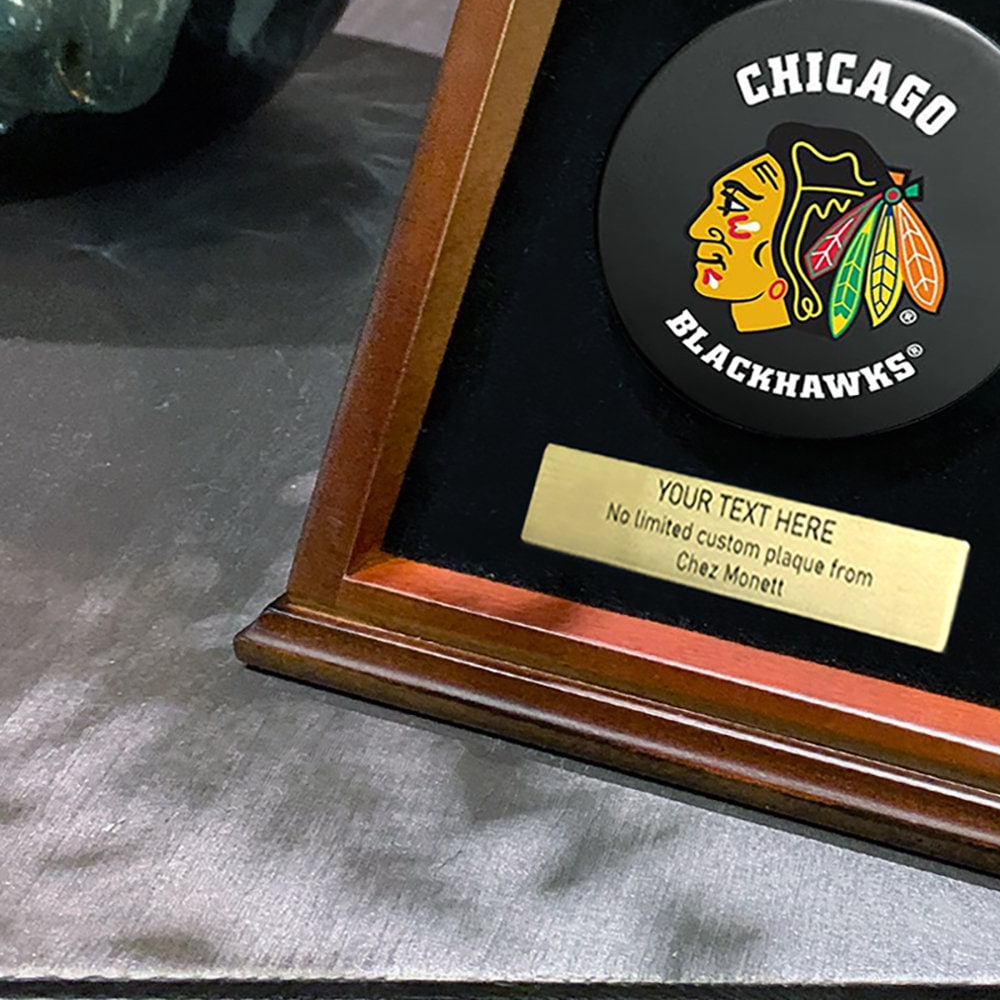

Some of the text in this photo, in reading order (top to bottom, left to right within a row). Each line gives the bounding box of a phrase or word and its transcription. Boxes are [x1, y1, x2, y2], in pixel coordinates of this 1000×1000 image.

[735, 51, 958, 136] CHICAGO
[606, 502, 873, 587] No limited custom plaque from
[657, 479, 837, 545] YOUR TEXT HERE
[676, 551, 784, 597] Chez Monett
